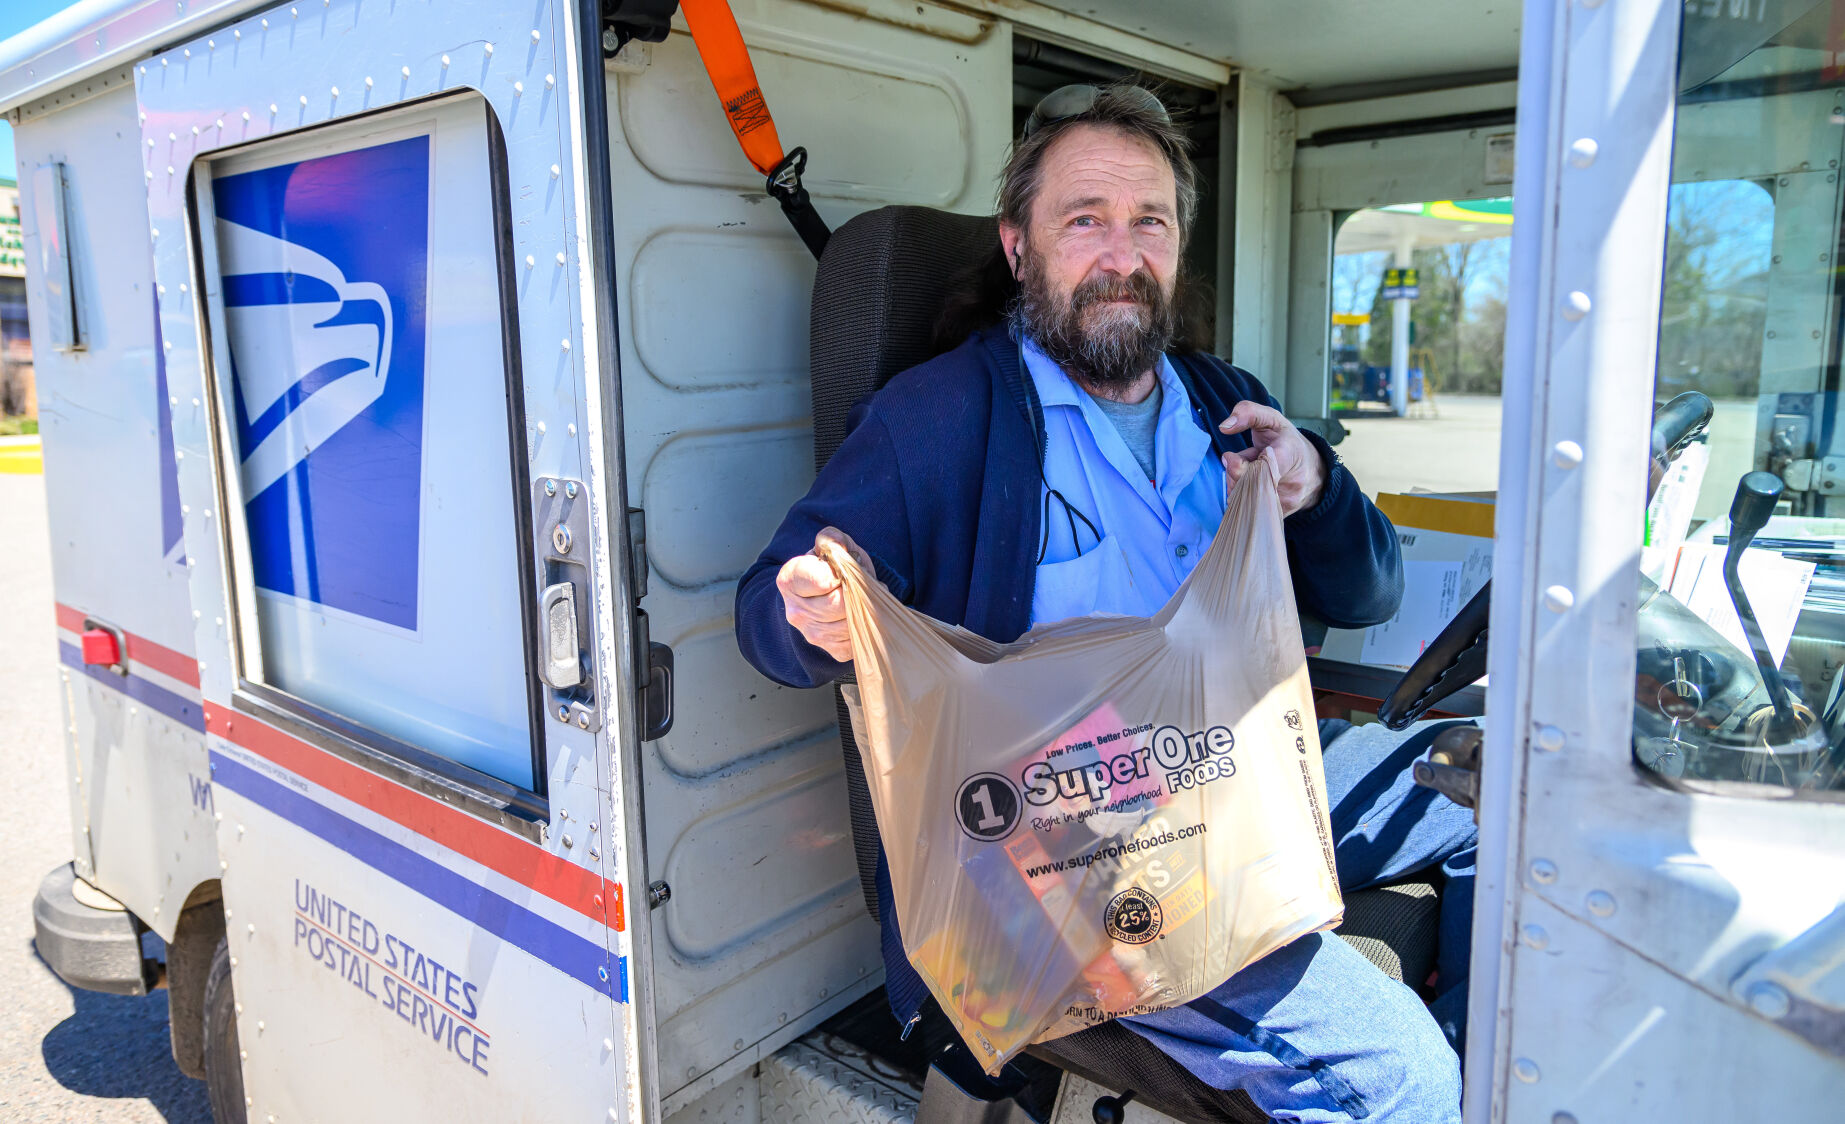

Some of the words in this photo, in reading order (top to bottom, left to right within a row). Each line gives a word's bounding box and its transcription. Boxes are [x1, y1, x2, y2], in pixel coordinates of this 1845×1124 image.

[1045, 749, 1064, 760] Low
[1065, 739, 1096, 754] Prices.
[1096, 732, 1121, 745] Better
[1122, 722, 1156, 738] Choices.
[1166, 756, 1237, 795] FOODS
[971, 783, 1006, 831] 1
[1031, 813, 1060, 832] Right
[1063, 812, 1073, 823] in
[1077, 805, 1101, 823] your
[1103, 785, 1163, 813] neighborhood
[1025, 821, 1208, 879] www.superonefoods.com
[1107, 905, 1118, 922] THIS
[1127, 889, 1158, 911] CONTAINS
[1119, 910, 1150, 928] 25%
[1125, 902, 1144, 910] least
[295, 878, 380, 956] UNITED
[384, 933, 478, 1020] STATES
[1137, 918, 1160, 942] CONTENT
[294, 917, 378, 1000] POSTAL
[382, 975, 491, 1076] SERVICE
[1085, 1006, 1097, 1020] TO
